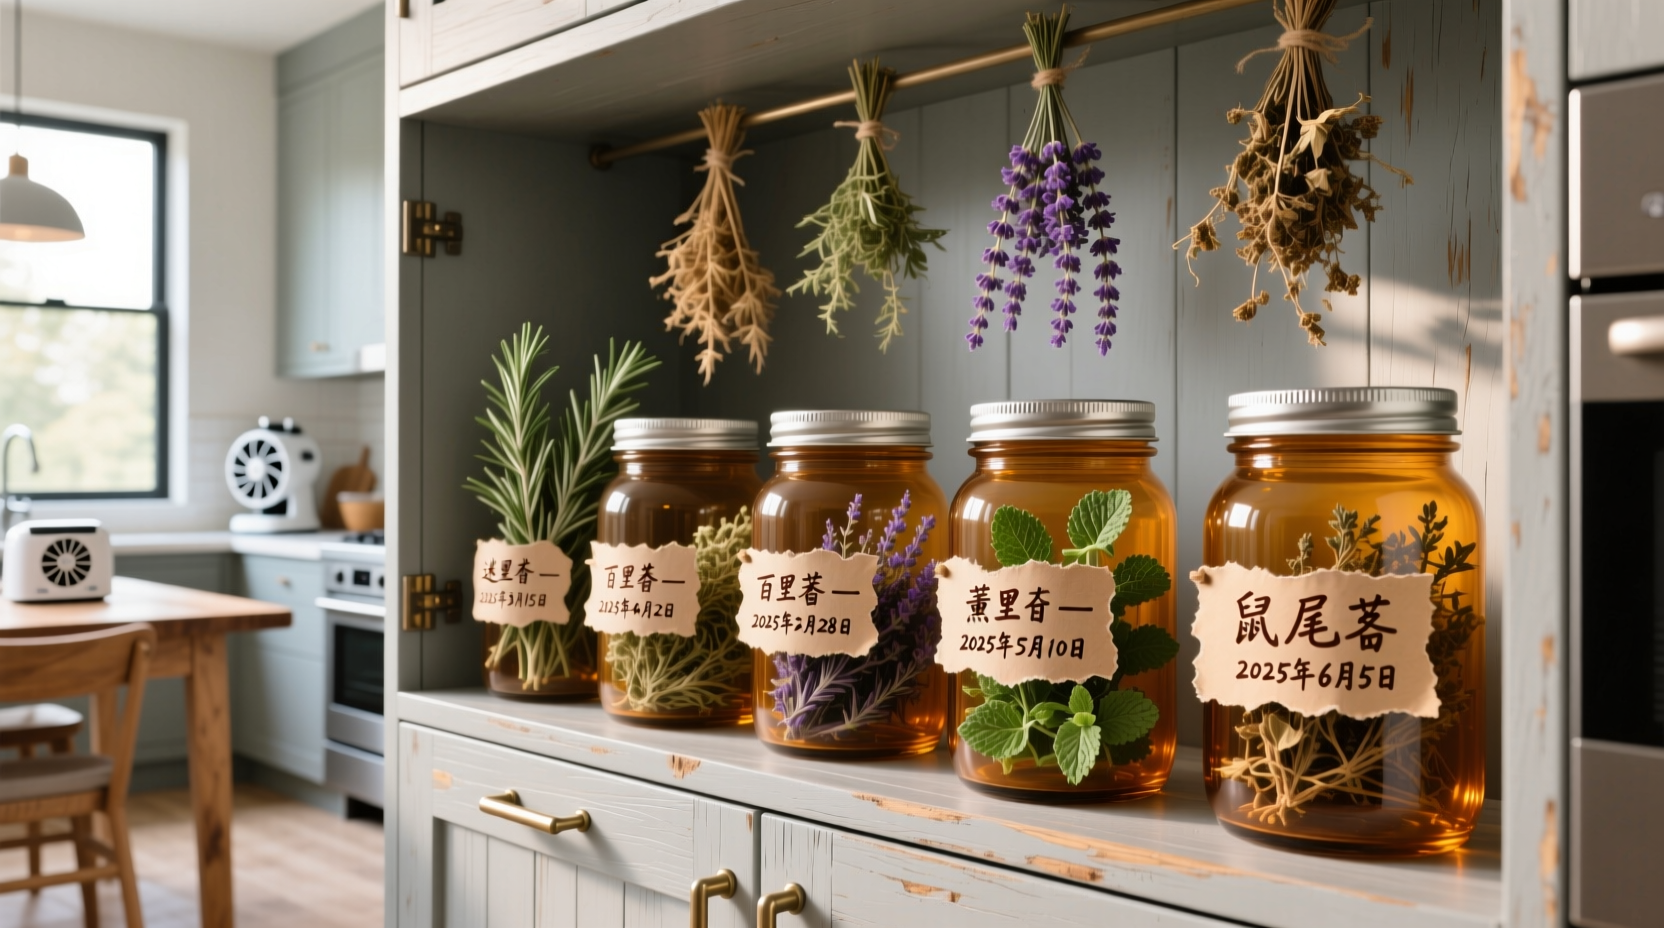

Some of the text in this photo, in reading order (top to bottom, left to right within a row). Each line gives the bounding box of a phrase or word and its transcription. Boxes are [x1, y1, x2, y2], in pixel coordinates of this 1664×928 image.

[960, 631, 1085, 660] 2025年5月10日
[1236, 657, 1396, 691] 2025年6月5日
